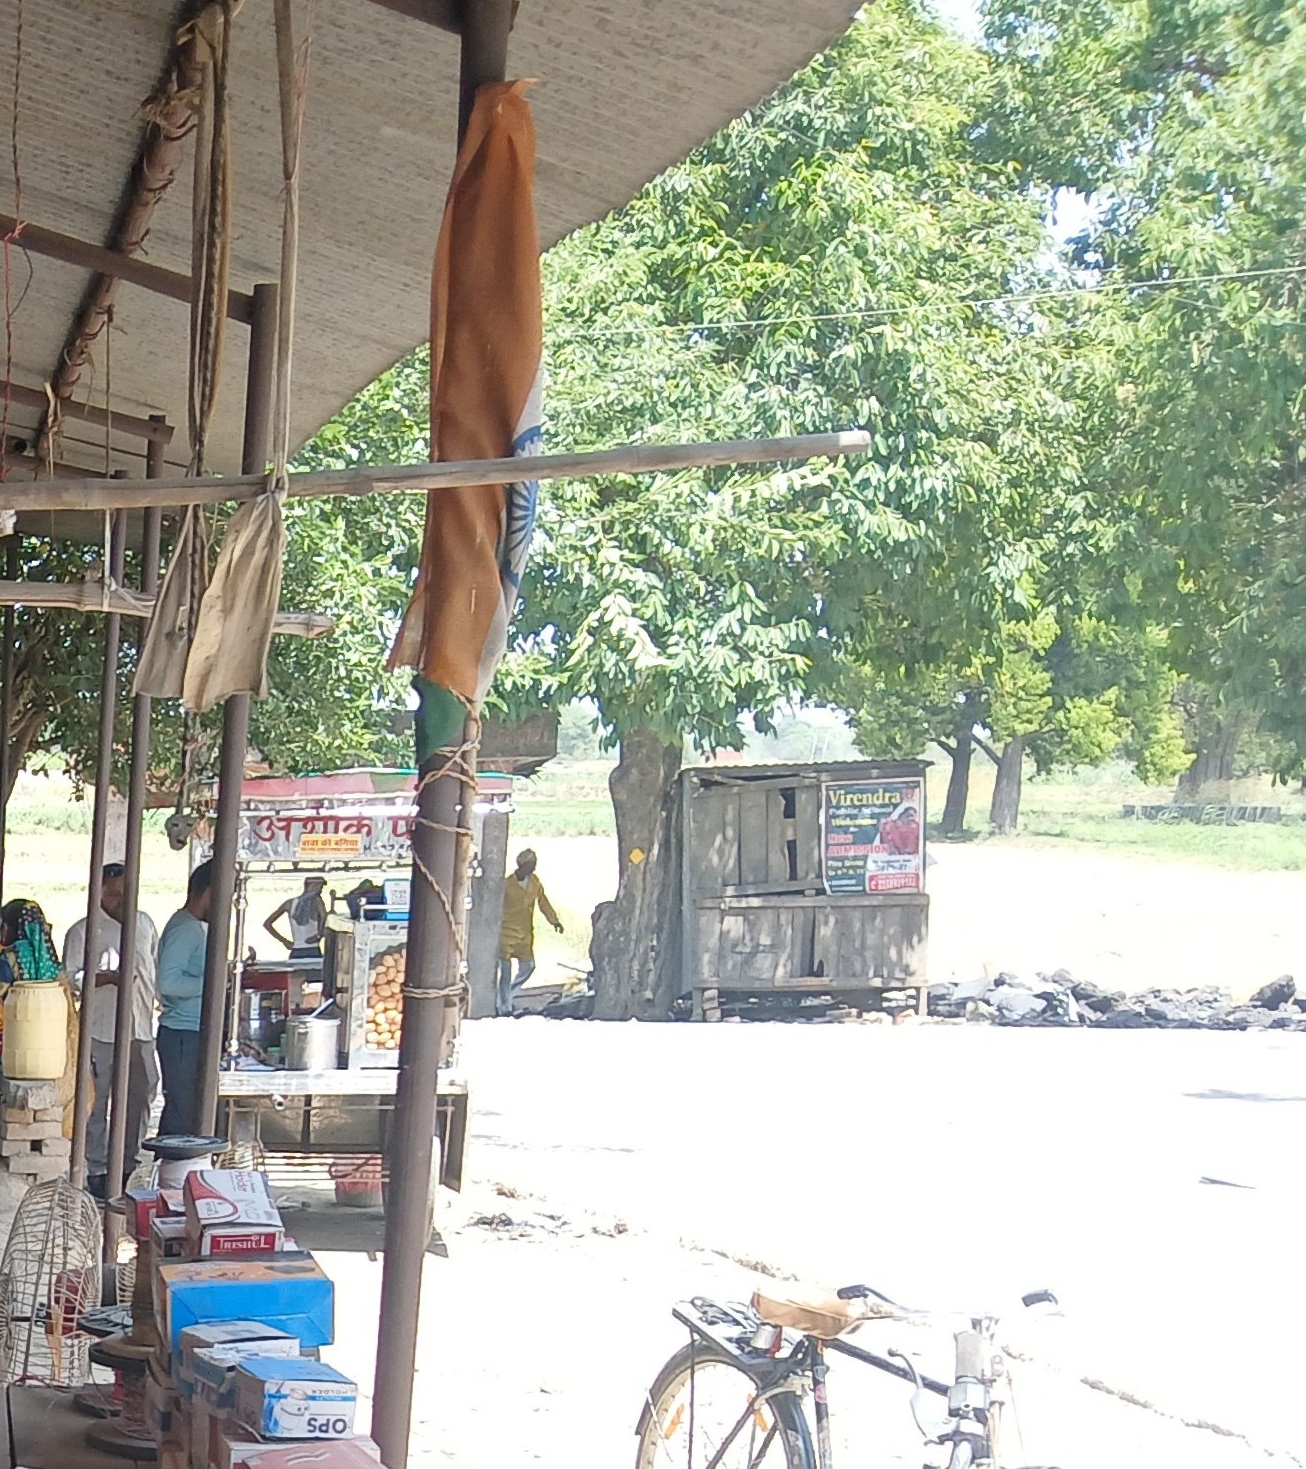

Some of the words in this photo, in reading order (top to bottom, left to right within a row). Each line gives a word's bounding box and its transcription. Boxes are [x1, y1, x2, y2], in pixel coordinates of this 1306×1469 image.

[828, 788, 901, 806] Virendra
[216, 1234, 270, 1250] TRISHUL
[306, 1417, 347, 1434] OPS
